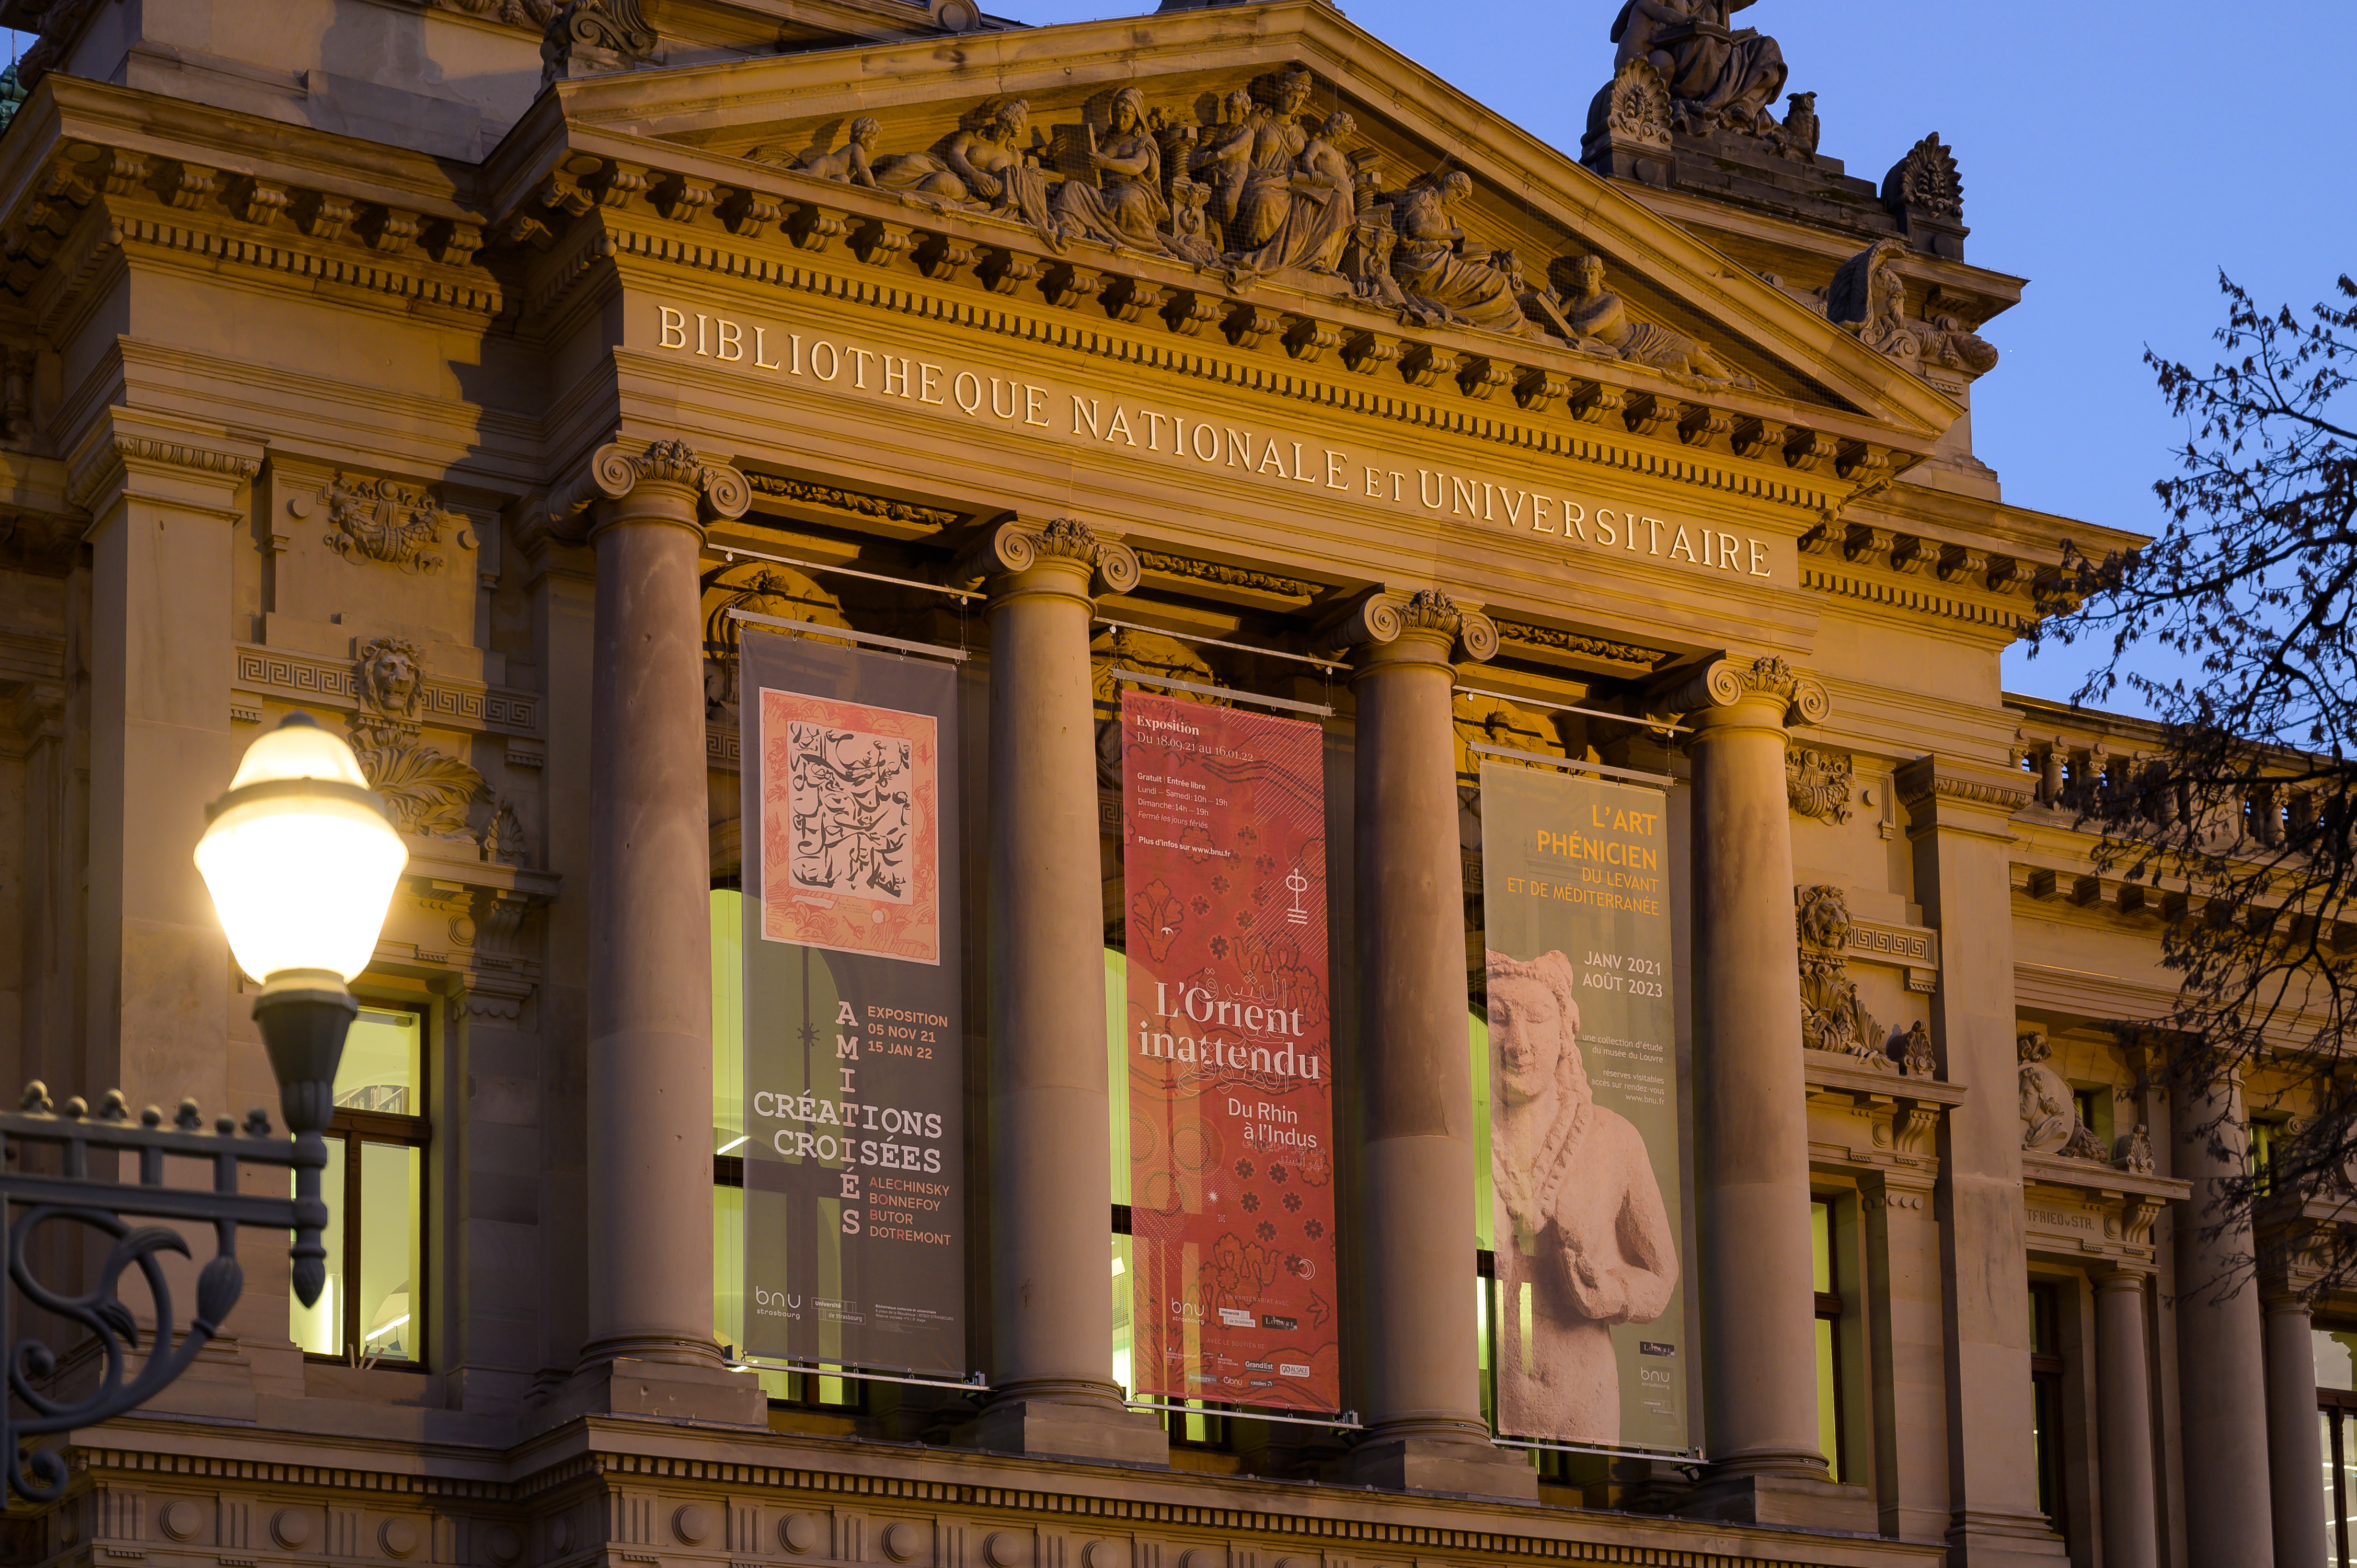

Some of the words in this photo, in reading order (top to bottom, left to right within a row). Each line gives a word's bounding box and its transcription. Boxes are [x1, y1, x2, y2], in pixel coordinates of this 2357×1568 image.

[658, 305, 1050, 427] BIBLIOTHEQUE
[1071, 395, 1349, 491] NATIONALE
[1364, 466, 1405, 502] ET
[1417, 469, 1771, 577] UNIVERSITAIRE
[1136, 714, 1199, 736] Exposition
[1137, 731, 1153, 744] Du
[1156, 735, 1196, 752] 18.09.21
[1199, 744, 1212, 754] au
[1215, 745, 1254, 762] 16.01.22
[1137, 772, 1162, 783] Gratuit
[1167, 776, 1189, 787] Entrée
[1190, 781, 1206, 790] libre
[1137, 785, 1157, 795] Lundi
[1194, 795, 1206, 803] 10h
[1215, 798, 1228, 806] 19h
[1175, 804, 1187, 812] 14h
[1138, 811, 1159, 821] Fermé
[1171, 816, 1188, 826] jours
[1189, 819, 1208, 829] fériés
[1592, 804, 1657, 836] L'ART
[1139, 836, 1154, 845] Plus
[1155, 839, 1178, 849] d'infos
[1191, 845, 1231, 858] www.bnu.fr
[1537, 829, 1657, 871] PHÉNICIEN
[1582, 867, 1601, 884] DU
[1607, 871, 1659, 893] LEVANT
[1508, 877, 1525, 894] ET
[1531, 881, 1548, 898] DE
[1554, 883, 1659, 916] MÉDITERRANÉE
[1584, 951, 1622, 970] JANV
[1627, 957, 1660, 976] 2021
[1582, 971, 1623, 991] AOÛT
[1628, 979, 1663, 998] 2023
[868, 1006, 948, 1027] EXPOSITION
[1154, 981, 1304, 1036] L'Orient
[868, 1023, 884, 1036] 05
[888, 1025, 916, 1040] NOV
[920, 1029, 936, 1043] 21
[868, 1041, 883, 1053] 15
[888, 1043, 913, 1057] JAN
[917, 1047, 932, 1059] 22
[1139, 1020, 1321, 1080] inattendu
[1597, 1036, 1633, 1047] collection
[1635, 1041, 1663, 1052] d'étude
[1592, 1046, 1601, 1054] du
[1603, 1048, 1626, 1057] musée
[1628, 1051, 1638, 1059] du
[1640, 1053, 1663, 1063] Louvre
[1591, 1078, 1610, 1087] accès
[1624, 1083, 1664, 1095] rendez-vous
[1603, 1069, 1631, 1079] réserves
[1633, 1073, 1664, 1084] visitables
[1625, 1093, 1665, 1105] www.bnu.fr
[754, 1089, 942, 1139] CRÉATIONS
[1228, 1098, 1252, 1118] Du
[1258, 1102, 1297, 1124] Rhin
[1244, 1122, 1254, 1140] à
[1259, 1124, 1317, 1148] l'Indus
[774, 1129, 941, 1173] CROISÉES
[869, 1176, 950, 1196] ALECHINSKY
[869, 1193, 940, 1212] BONNEFOY
[869, 1209, 913, 1225] BUTOR
[2024, 1208, 2063, 1225] TFRIED
[2071, 1215, 2095, 1230] STR.
[869, 1226, 951, 1246] DOTREMONT
[756, 1286, 801, 1308] bnu
[1171, 1297, 1204, 1317] bnu
[1235, 1295, 1272, 1304] PARTENARIAT
[756, 1308, 800, 1320] strasbourg
[835, 1313, 862, 1322] Strasbourg
[1172, 1316, 1204, 1325] strasbourg
[1266, 1318, 1294, 1327] LOUVRE
[1644, 1344, 1671, 1353] LOUVRE
[1640, 1367, 1670, 1382] bnu
